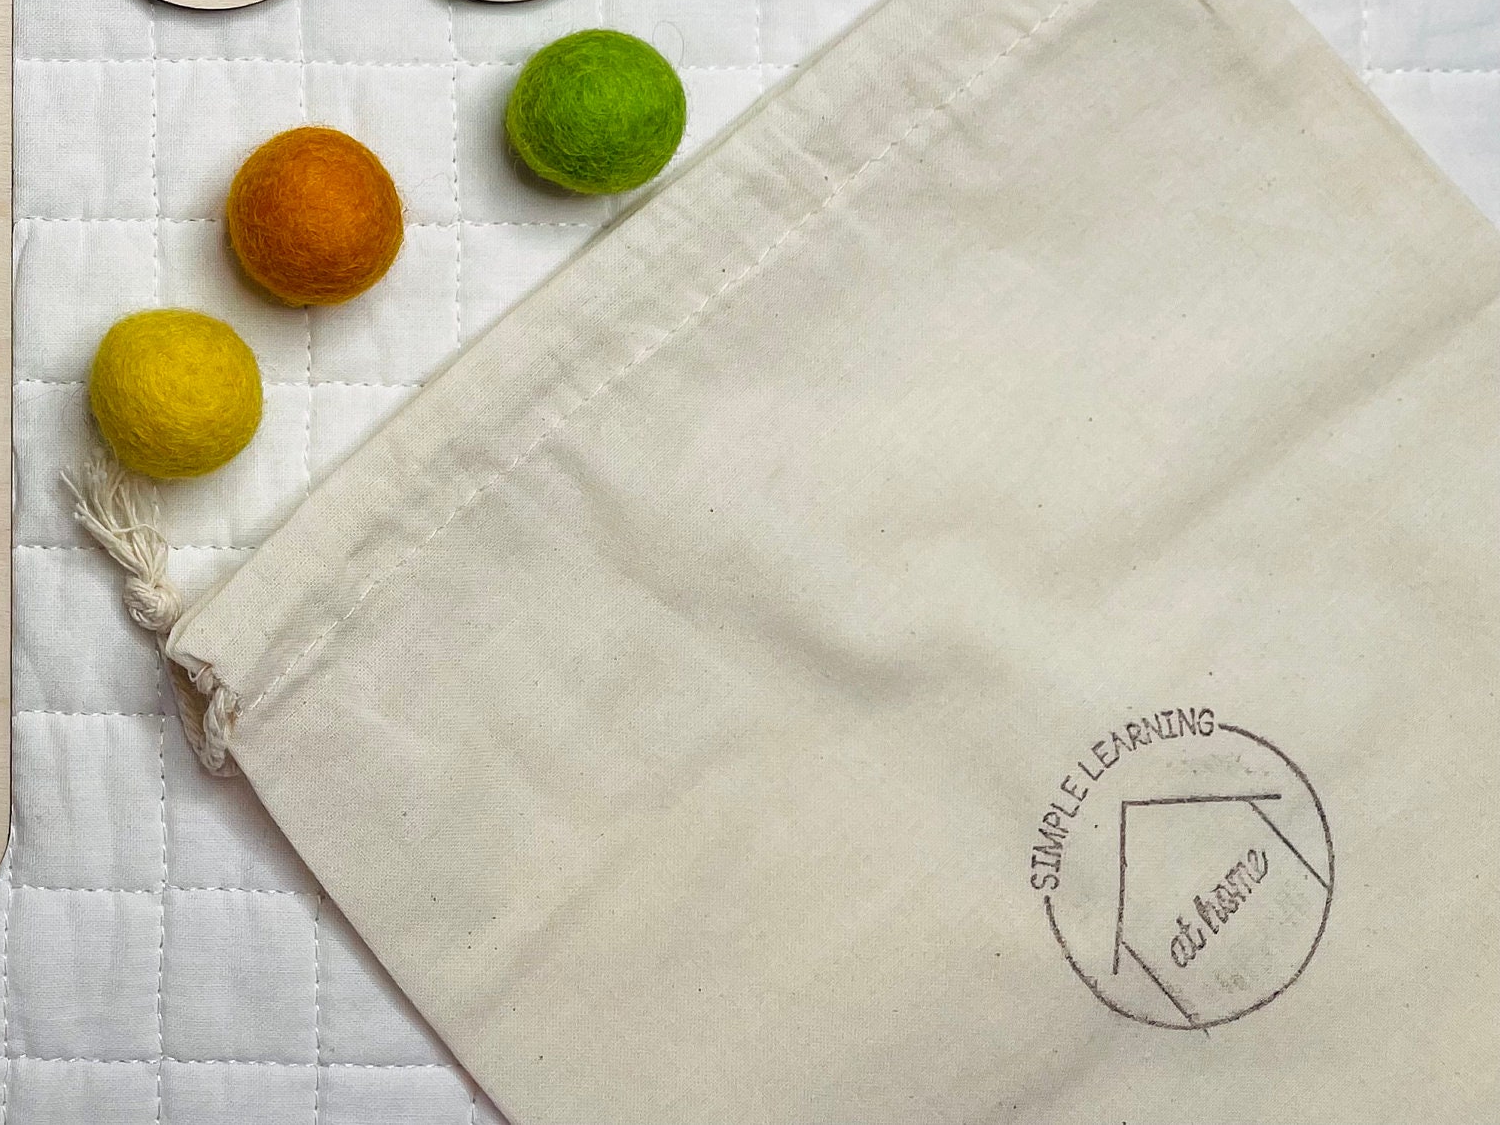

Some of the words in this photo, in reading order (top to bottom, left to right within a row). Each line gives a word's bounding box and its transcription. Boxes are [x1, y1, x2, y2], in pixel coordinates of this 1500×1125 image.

[1030, 775, 1088, 891] SIMPLE
[1078, 707, 1215, 782] LEARNING
[1170, 915, 1206, 968] at
[1193, 848, 1268, 935] home
